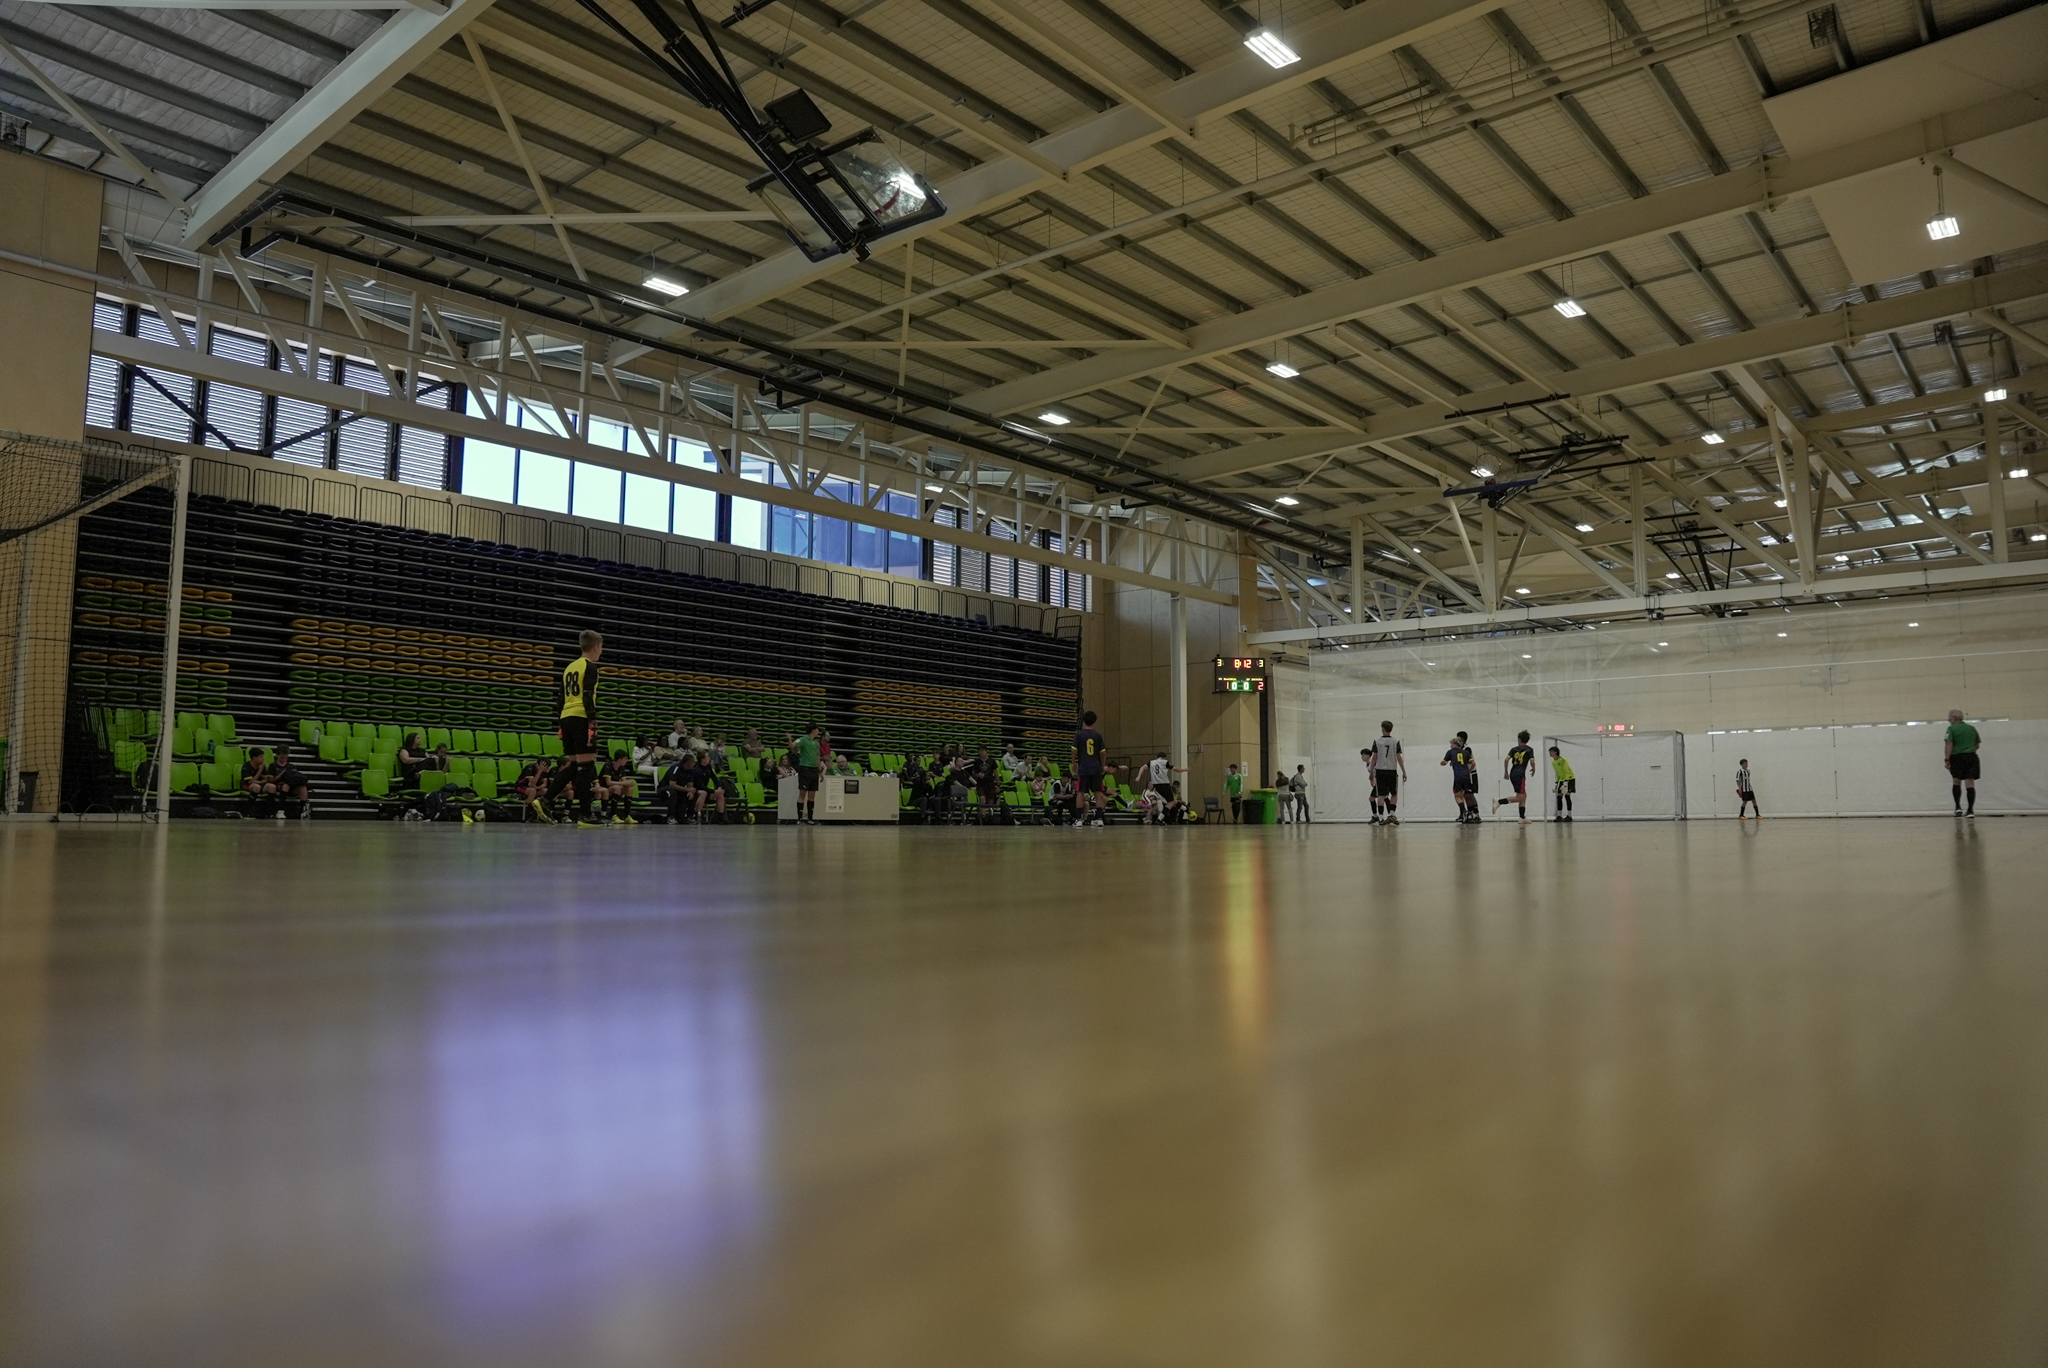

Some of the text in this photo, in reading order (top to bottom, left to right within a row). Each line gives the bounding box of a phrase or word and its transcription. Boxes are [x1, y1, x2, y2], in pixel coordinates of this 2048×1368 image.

[1217, 658, 1222, 666] 3
[1258, 659, 1263, 667] 3
[565, 671, 581, 697] 88
[1232, 681, 1237, 690] 0
[1243, 681, 1249, 690] 0
[1258, 682, 1264, 690] 2
[1086, 738, 1094, 755] 6
[1385, 745, 1390, 758] 7
[1155, 764, 1160, 774] 9
